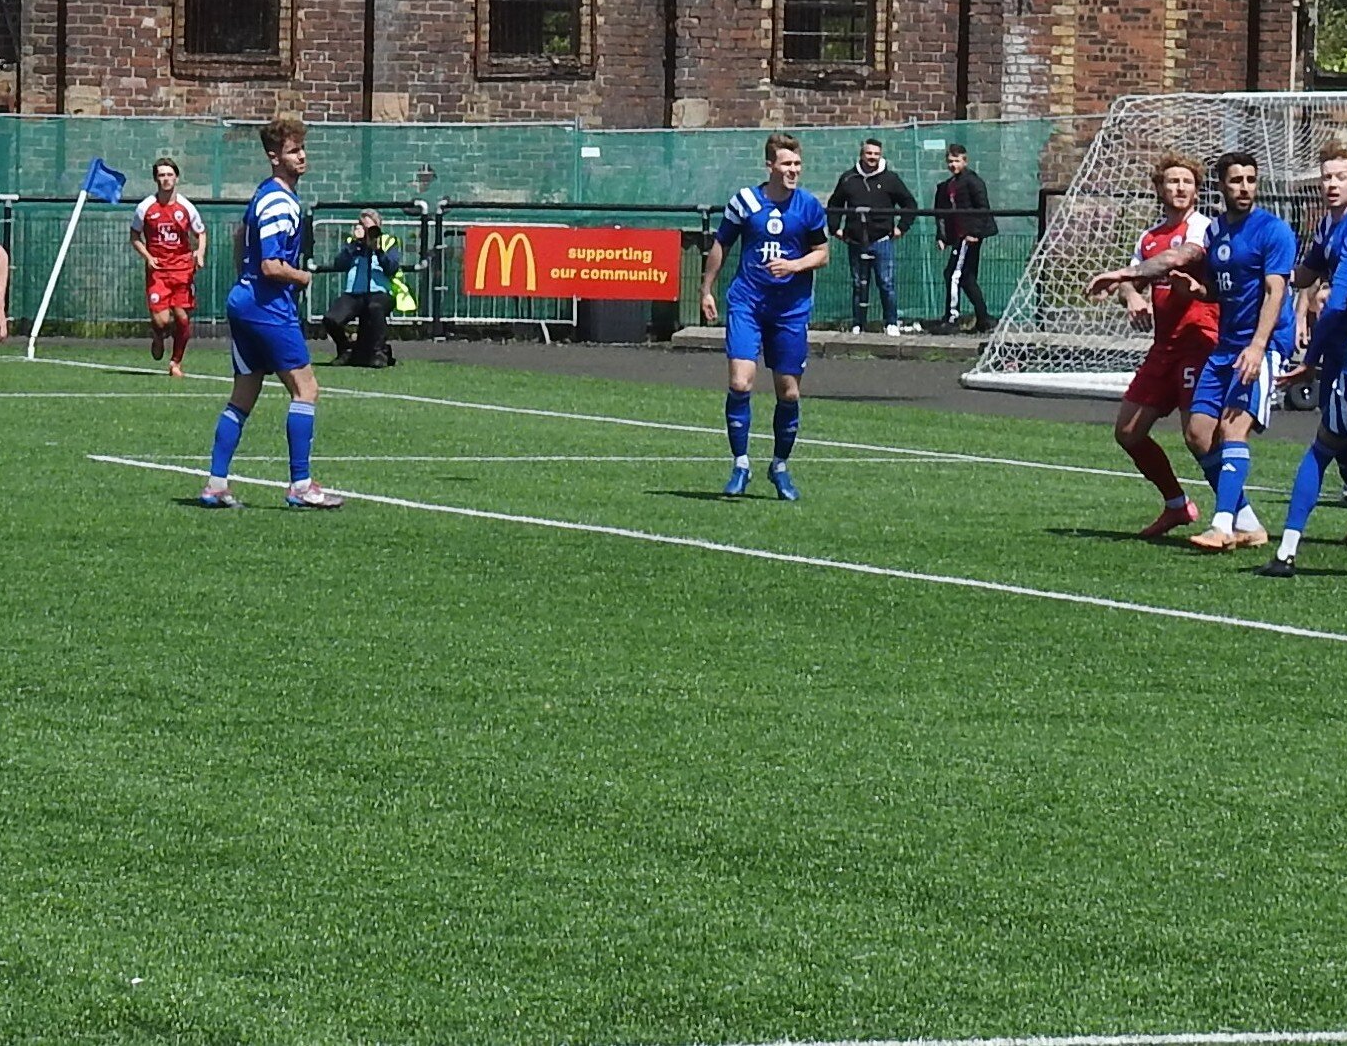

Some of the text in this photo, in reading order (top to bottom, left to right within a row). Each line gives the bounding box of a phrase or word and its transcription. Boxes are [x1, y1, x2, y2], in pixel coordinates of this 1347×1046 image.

[568, 247, 652, 263] supporting
[550, 267, 668, 284] our community
[1183, 366, 1196, 389] 5
